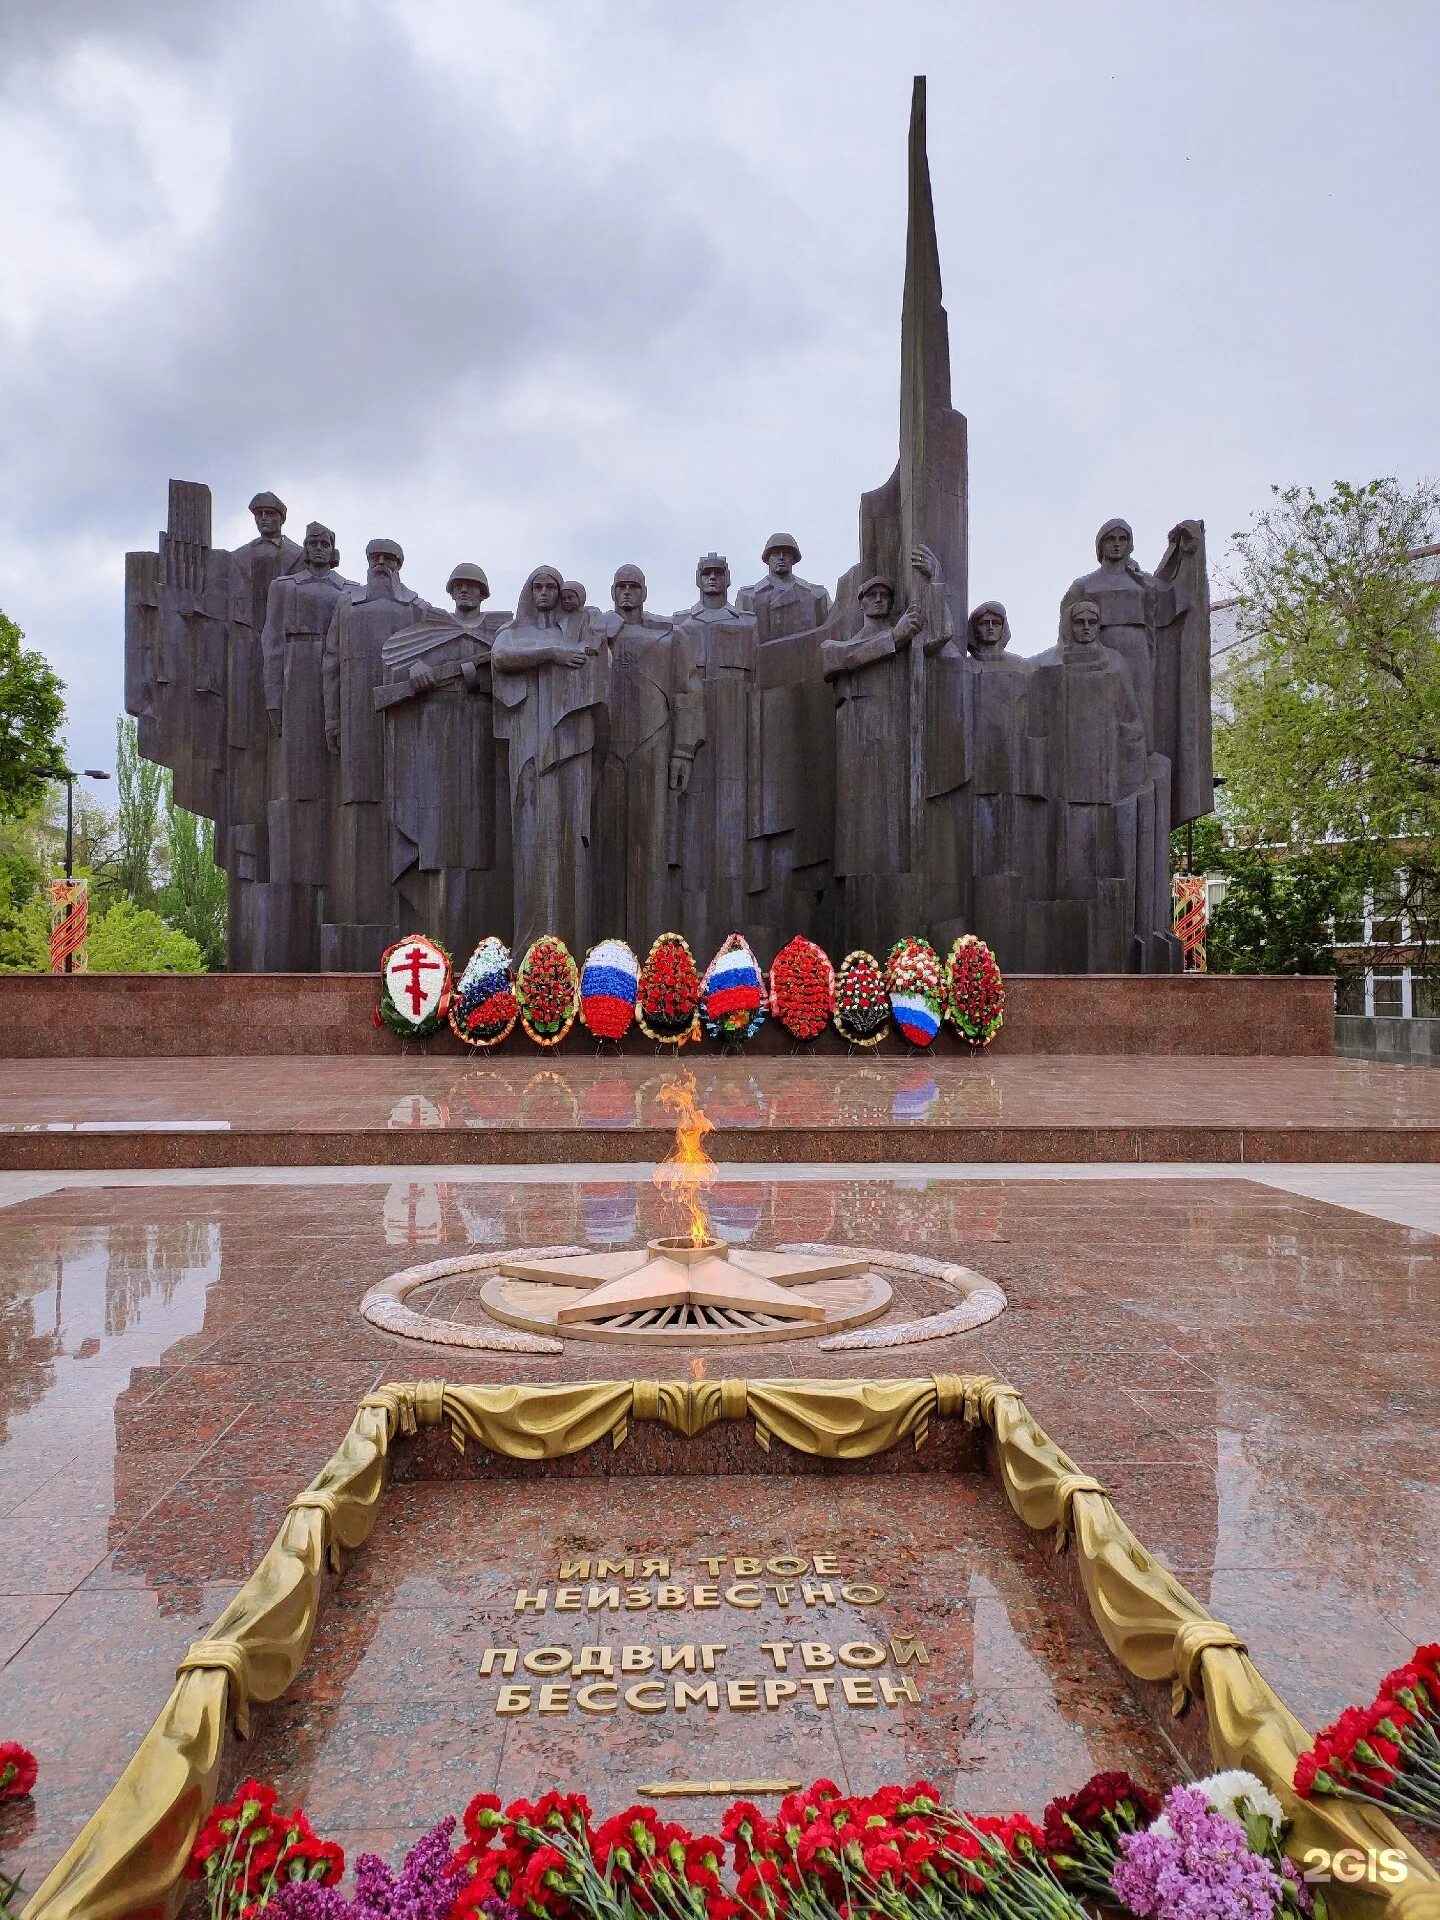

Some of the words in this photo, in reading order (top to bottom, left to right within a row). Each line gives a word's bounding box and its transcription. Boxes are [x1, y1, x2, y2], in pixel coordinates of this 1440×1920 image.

[558, 1557, 671, 1580] ИМЯ
[513, 1584, 886, 1612] НЕИЗВЕСТНО
[479, 1645, 727, 1677] ПОДВИГ
[761, 1633, 930, 1670] ТВОЙ
[495, 1677, 922, 1714] БЕССМЕРТЕН
